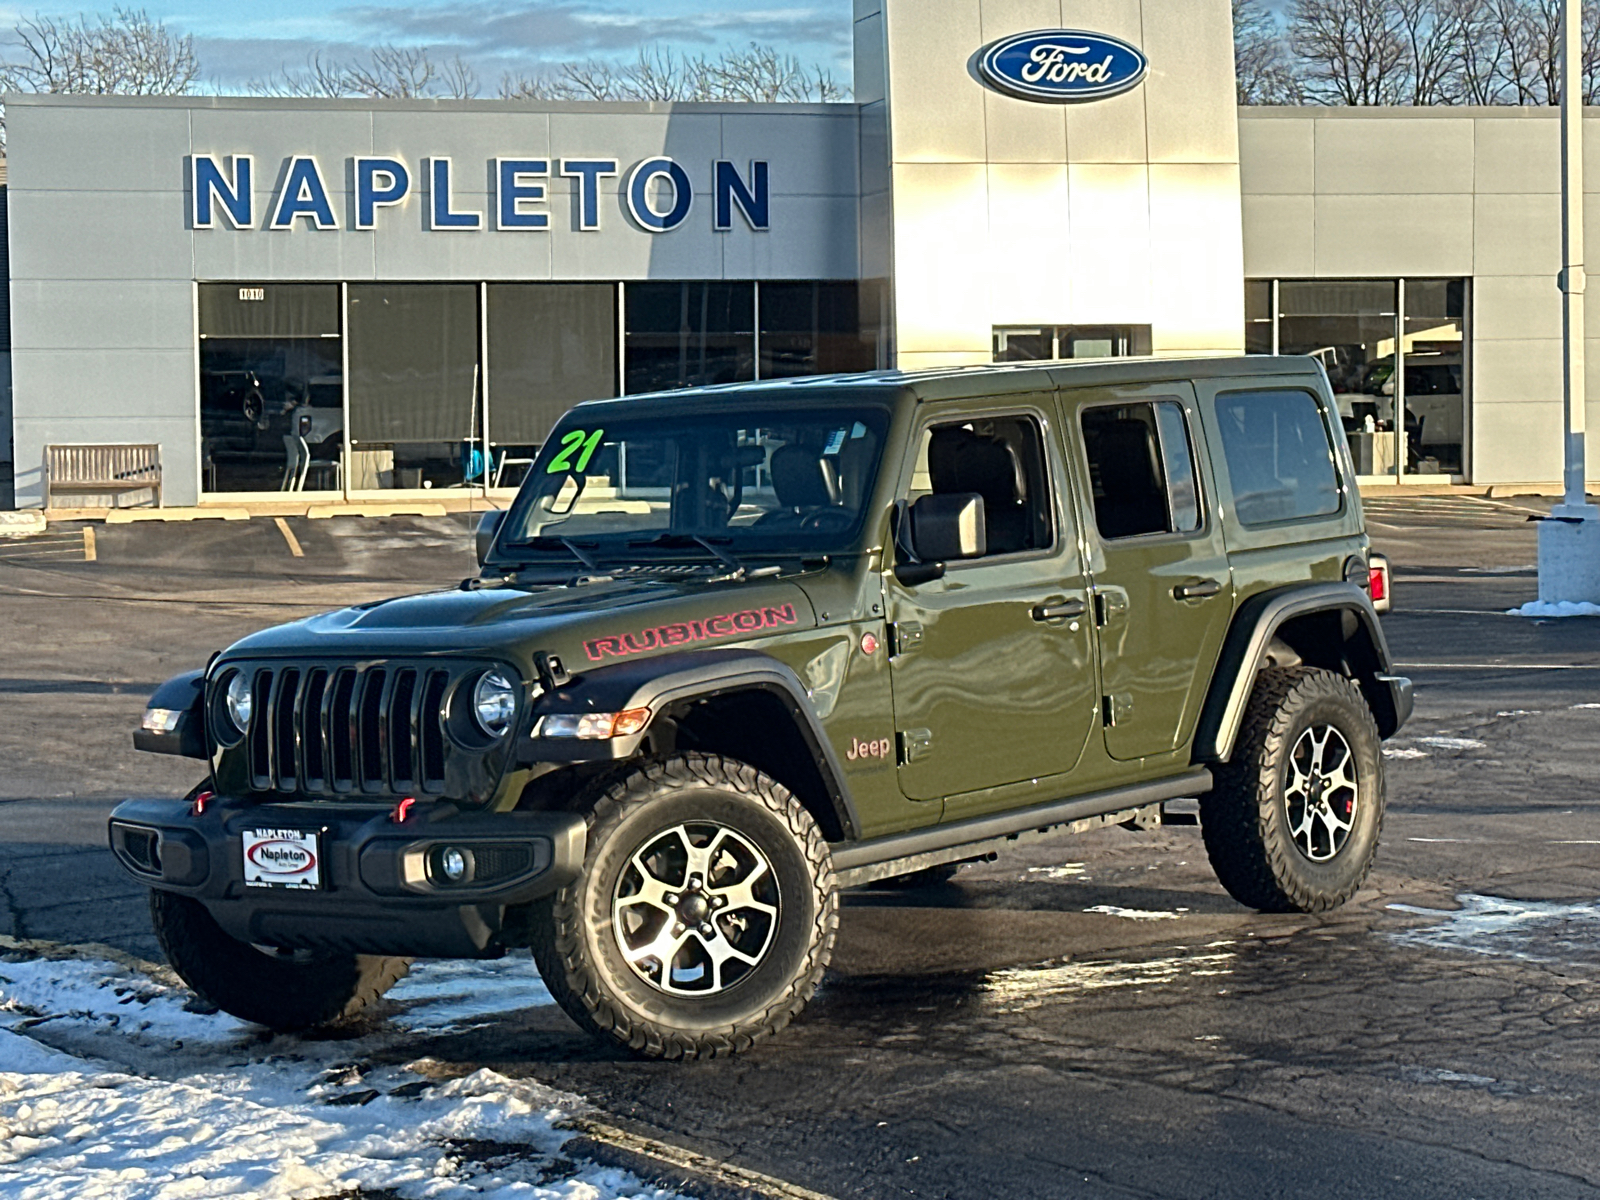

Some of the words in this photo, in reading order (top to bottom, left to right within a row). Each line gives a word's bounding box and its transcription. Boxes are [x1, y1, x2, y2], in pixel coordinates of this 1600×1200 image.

[1021, 44, 1114, 83] Ford
[190, 153, 771, 232] NAPLETON
[241, 288, 263, 300] 1010
[547, 429, 604, 474] 21
[583, 603, 798, 660] RUBICON
[845, 736, 891, 761] Jeep
[255, 828, 301, 840] NAPLETON
[260, 848, 305, 862] Napleton
